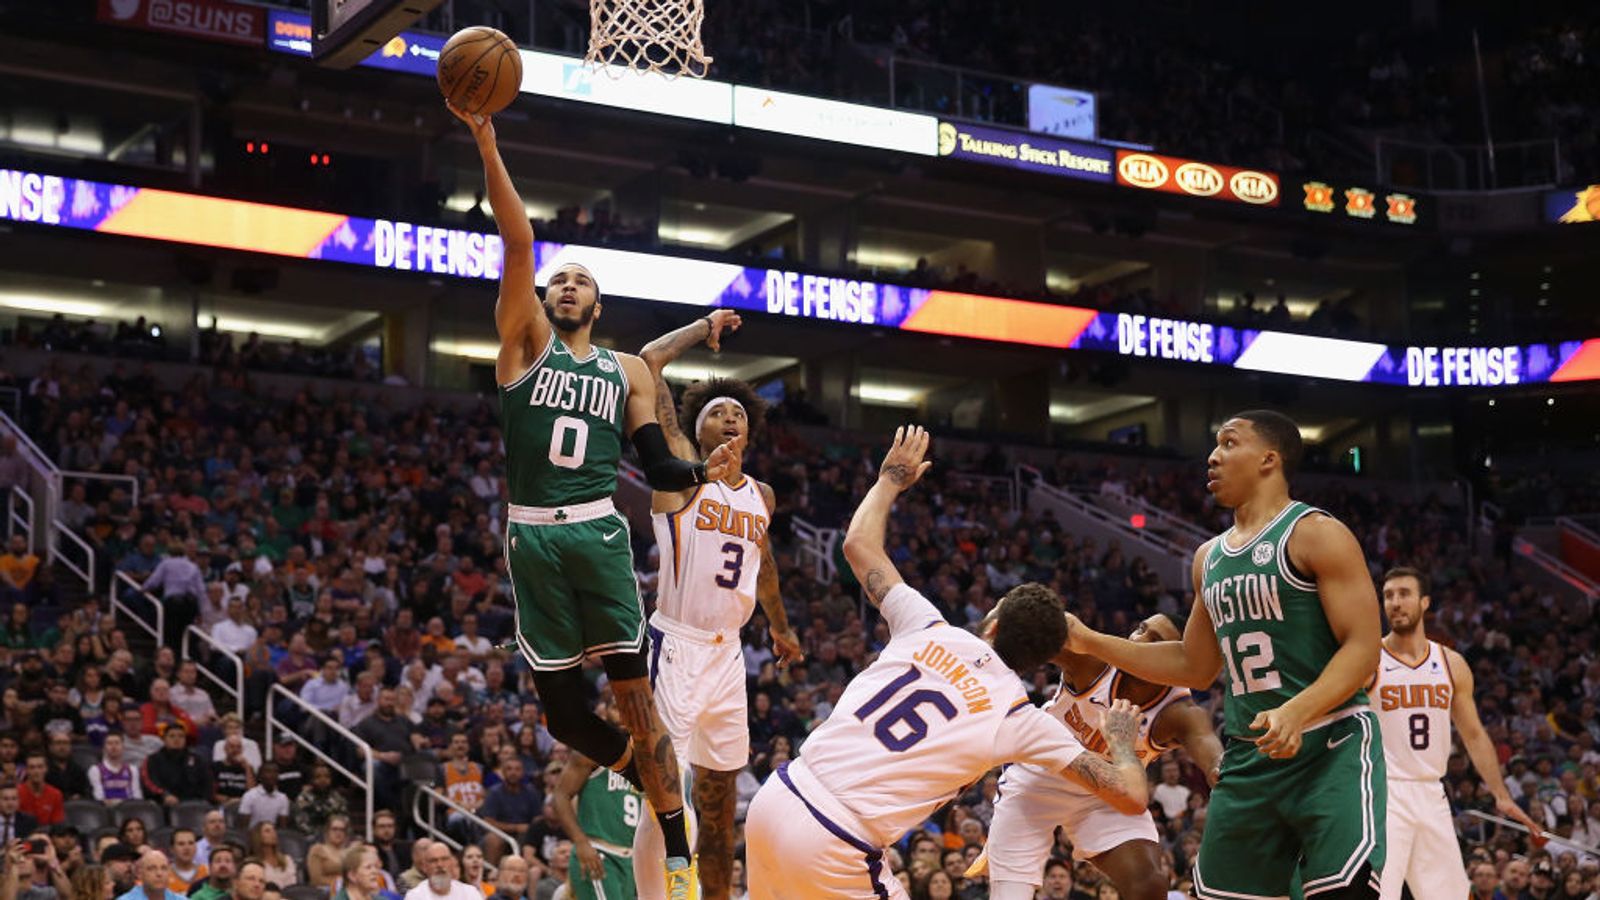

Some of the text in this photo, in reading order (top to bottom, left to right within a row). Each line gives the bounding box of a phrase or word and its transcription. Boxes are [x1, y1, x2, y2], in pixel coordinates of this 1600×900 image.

[149, 1, 253, 36] @SUNS
[958, 133, 1112, 174] TALKING STICK RESORT
[375, 219, 502, 280] DE FENSE
[766, 269, 876, 324] DE FENSE
[1118, 313, 1214, 363] DE FENSE
[1406, 346, 1520, 386] DE FENSE
[529, 367, 621, 425] BOSTON
[548, 415, 589, 470] 0
[715, 542, 744, 590] 3
[913, 640, 993, 715] JOHNSON
[1221, 631, 1282, 697] 12
[853, 663, 958, 752] 16
[1380, 684, 1450, 712] SUNS
[1408, 713, 1430, 751] 8
[623, 794, 640, 827] 9
